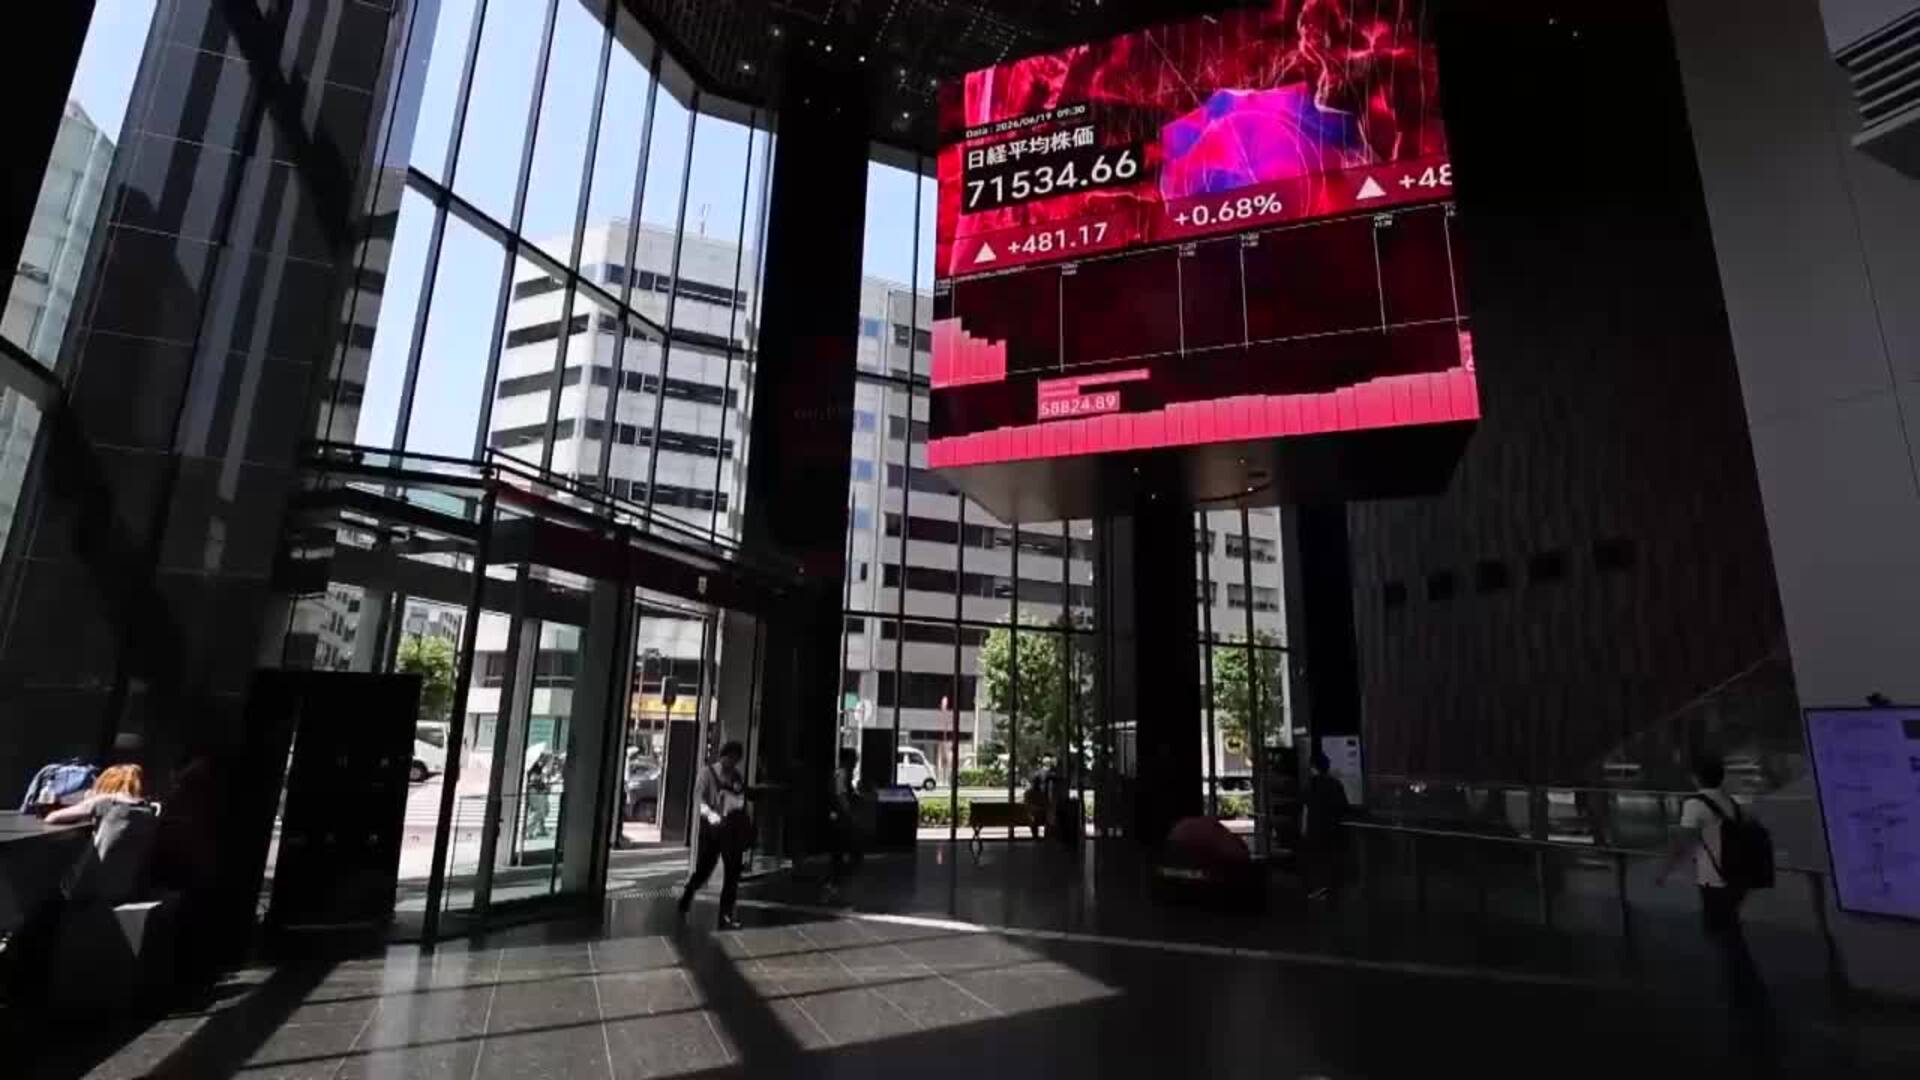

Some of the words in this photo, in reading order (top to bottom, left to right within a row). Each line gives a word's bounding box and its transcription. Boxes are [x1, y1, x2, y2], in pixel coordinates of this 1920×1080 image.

[967, 125, 1095, 170] 日経平均株価
[967, 150, 1137, 208] 71534.66
[1008, 222, 1108, 254] +481.17
[1174, 192, 1282, 226] +0.68%
